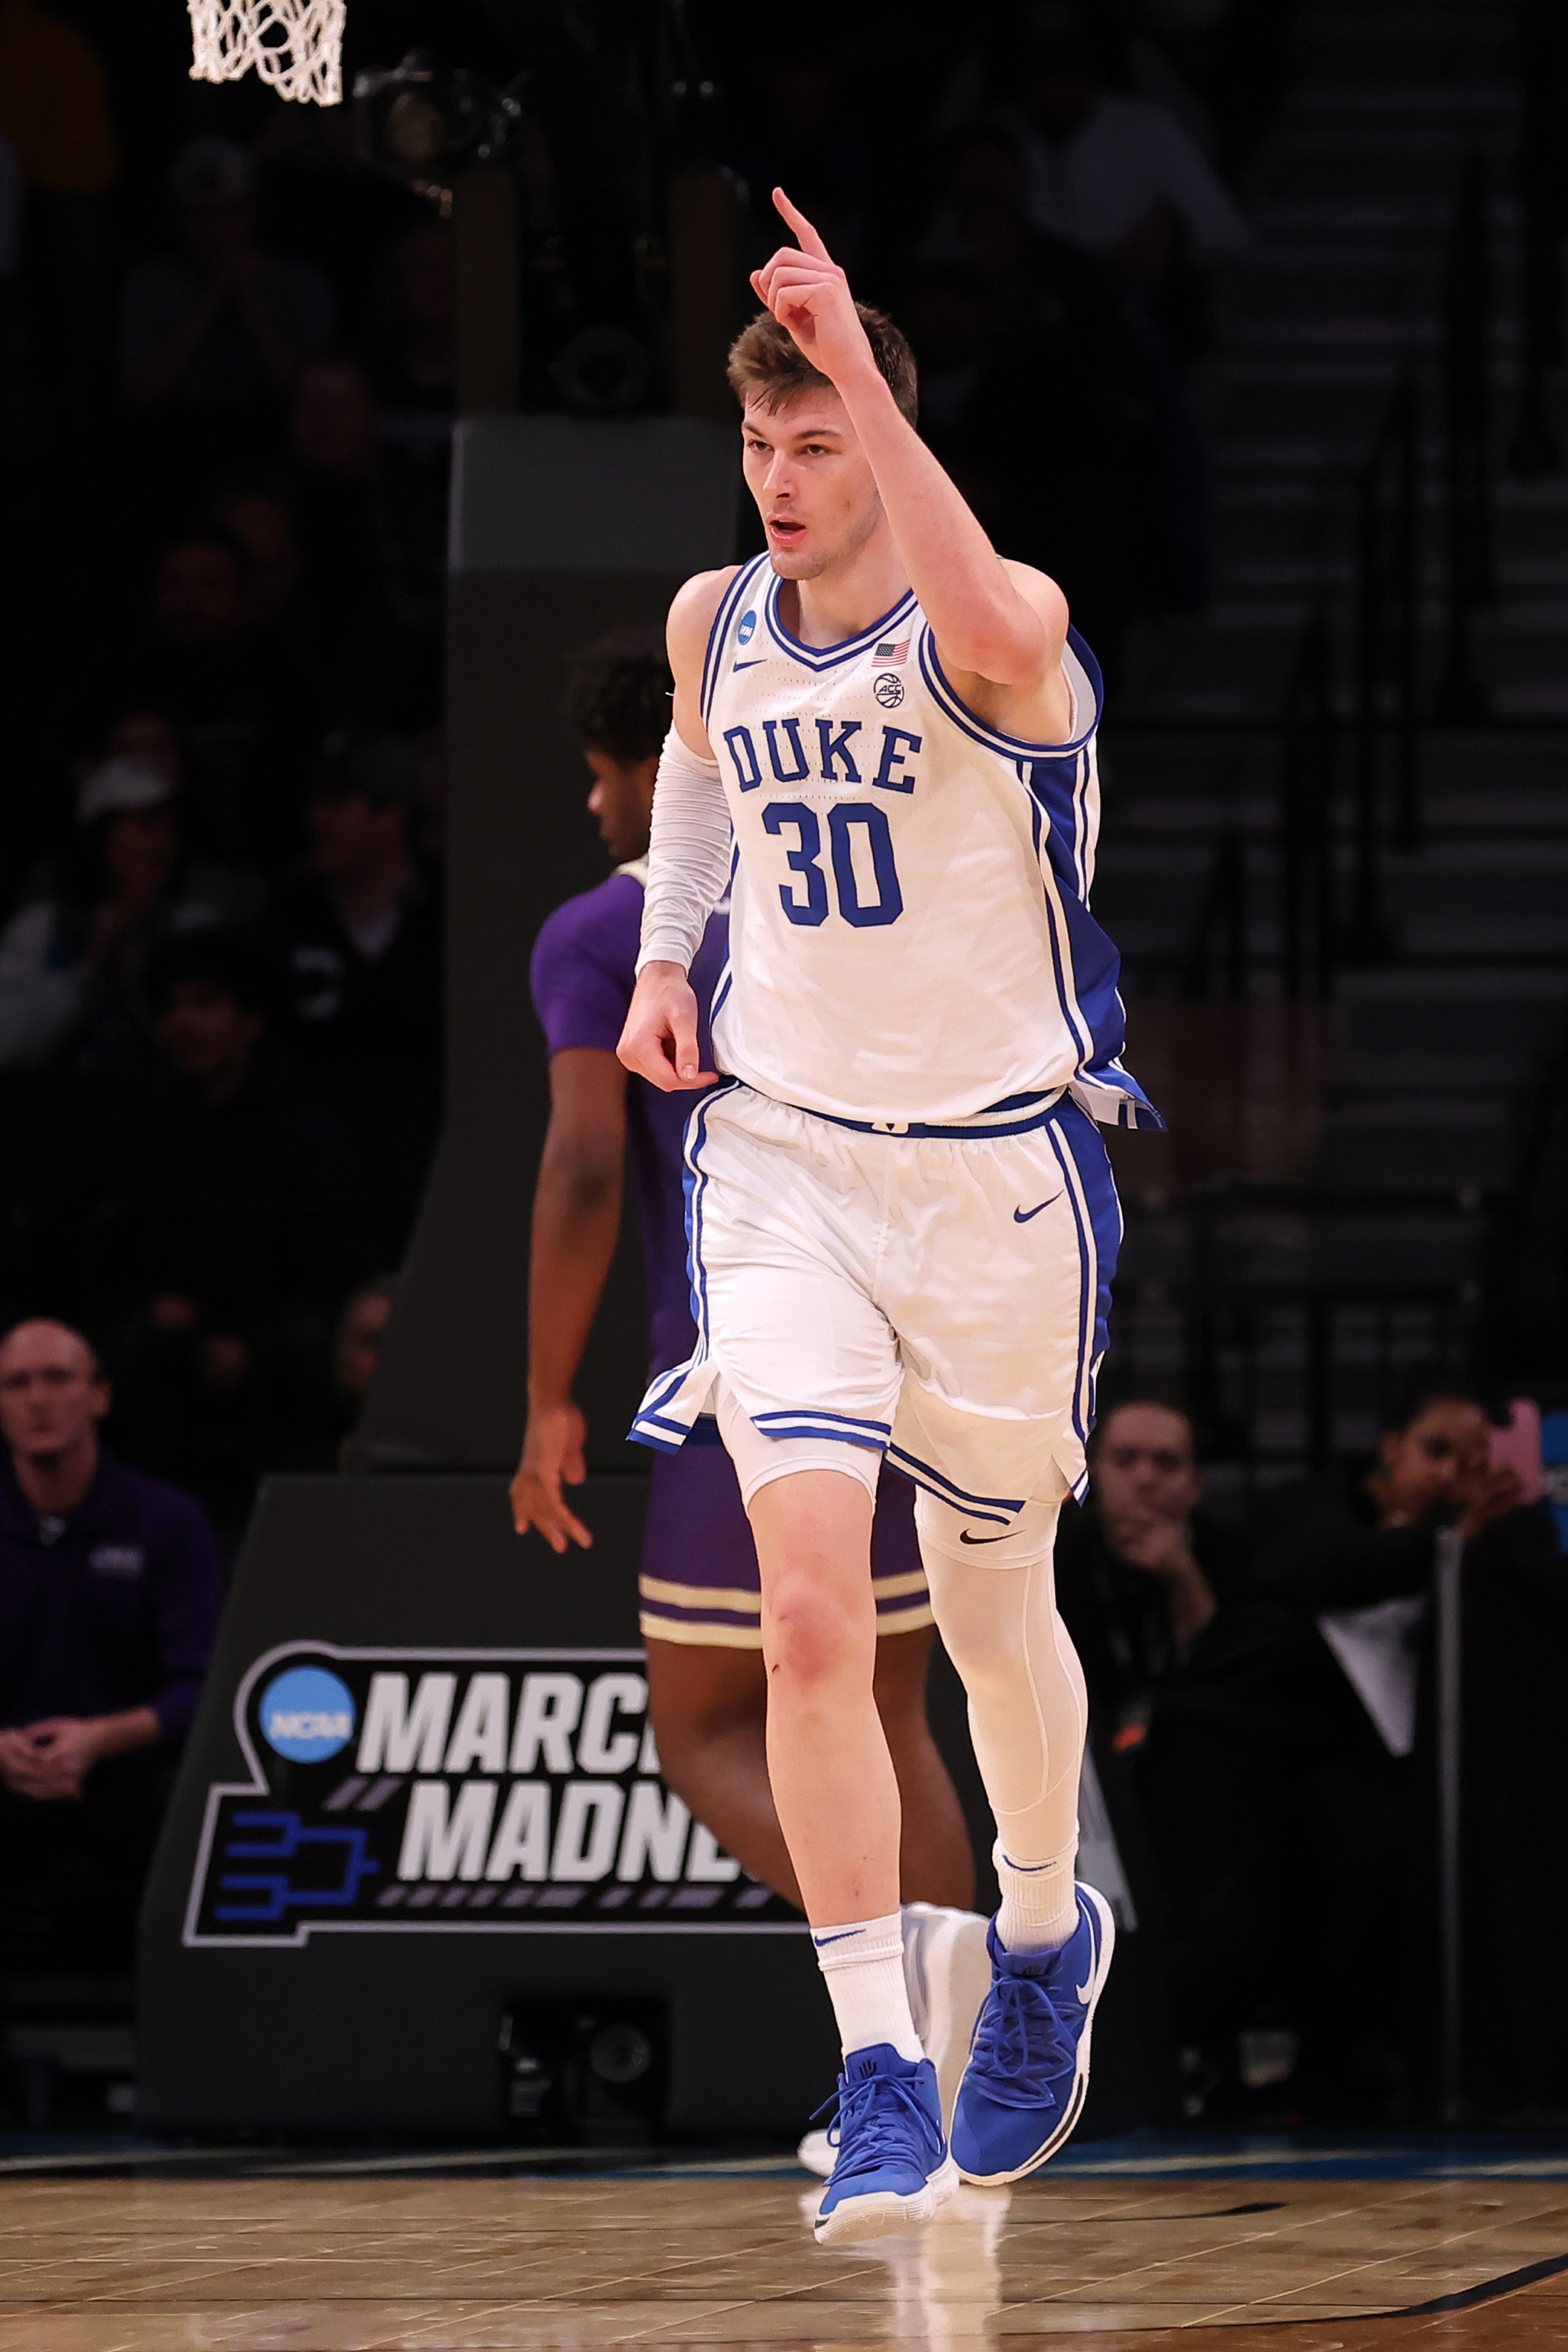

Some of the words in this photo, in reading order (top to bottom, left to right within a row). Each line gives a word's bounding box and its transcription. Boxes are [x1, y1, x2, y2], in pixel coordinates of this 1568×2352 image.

[878, 684, 902, 693] ACC
[723, 718, 922, 794] DUKE
[761, 802, 904, 927] 30
[396, 1781, 759, 1882] MADNE
